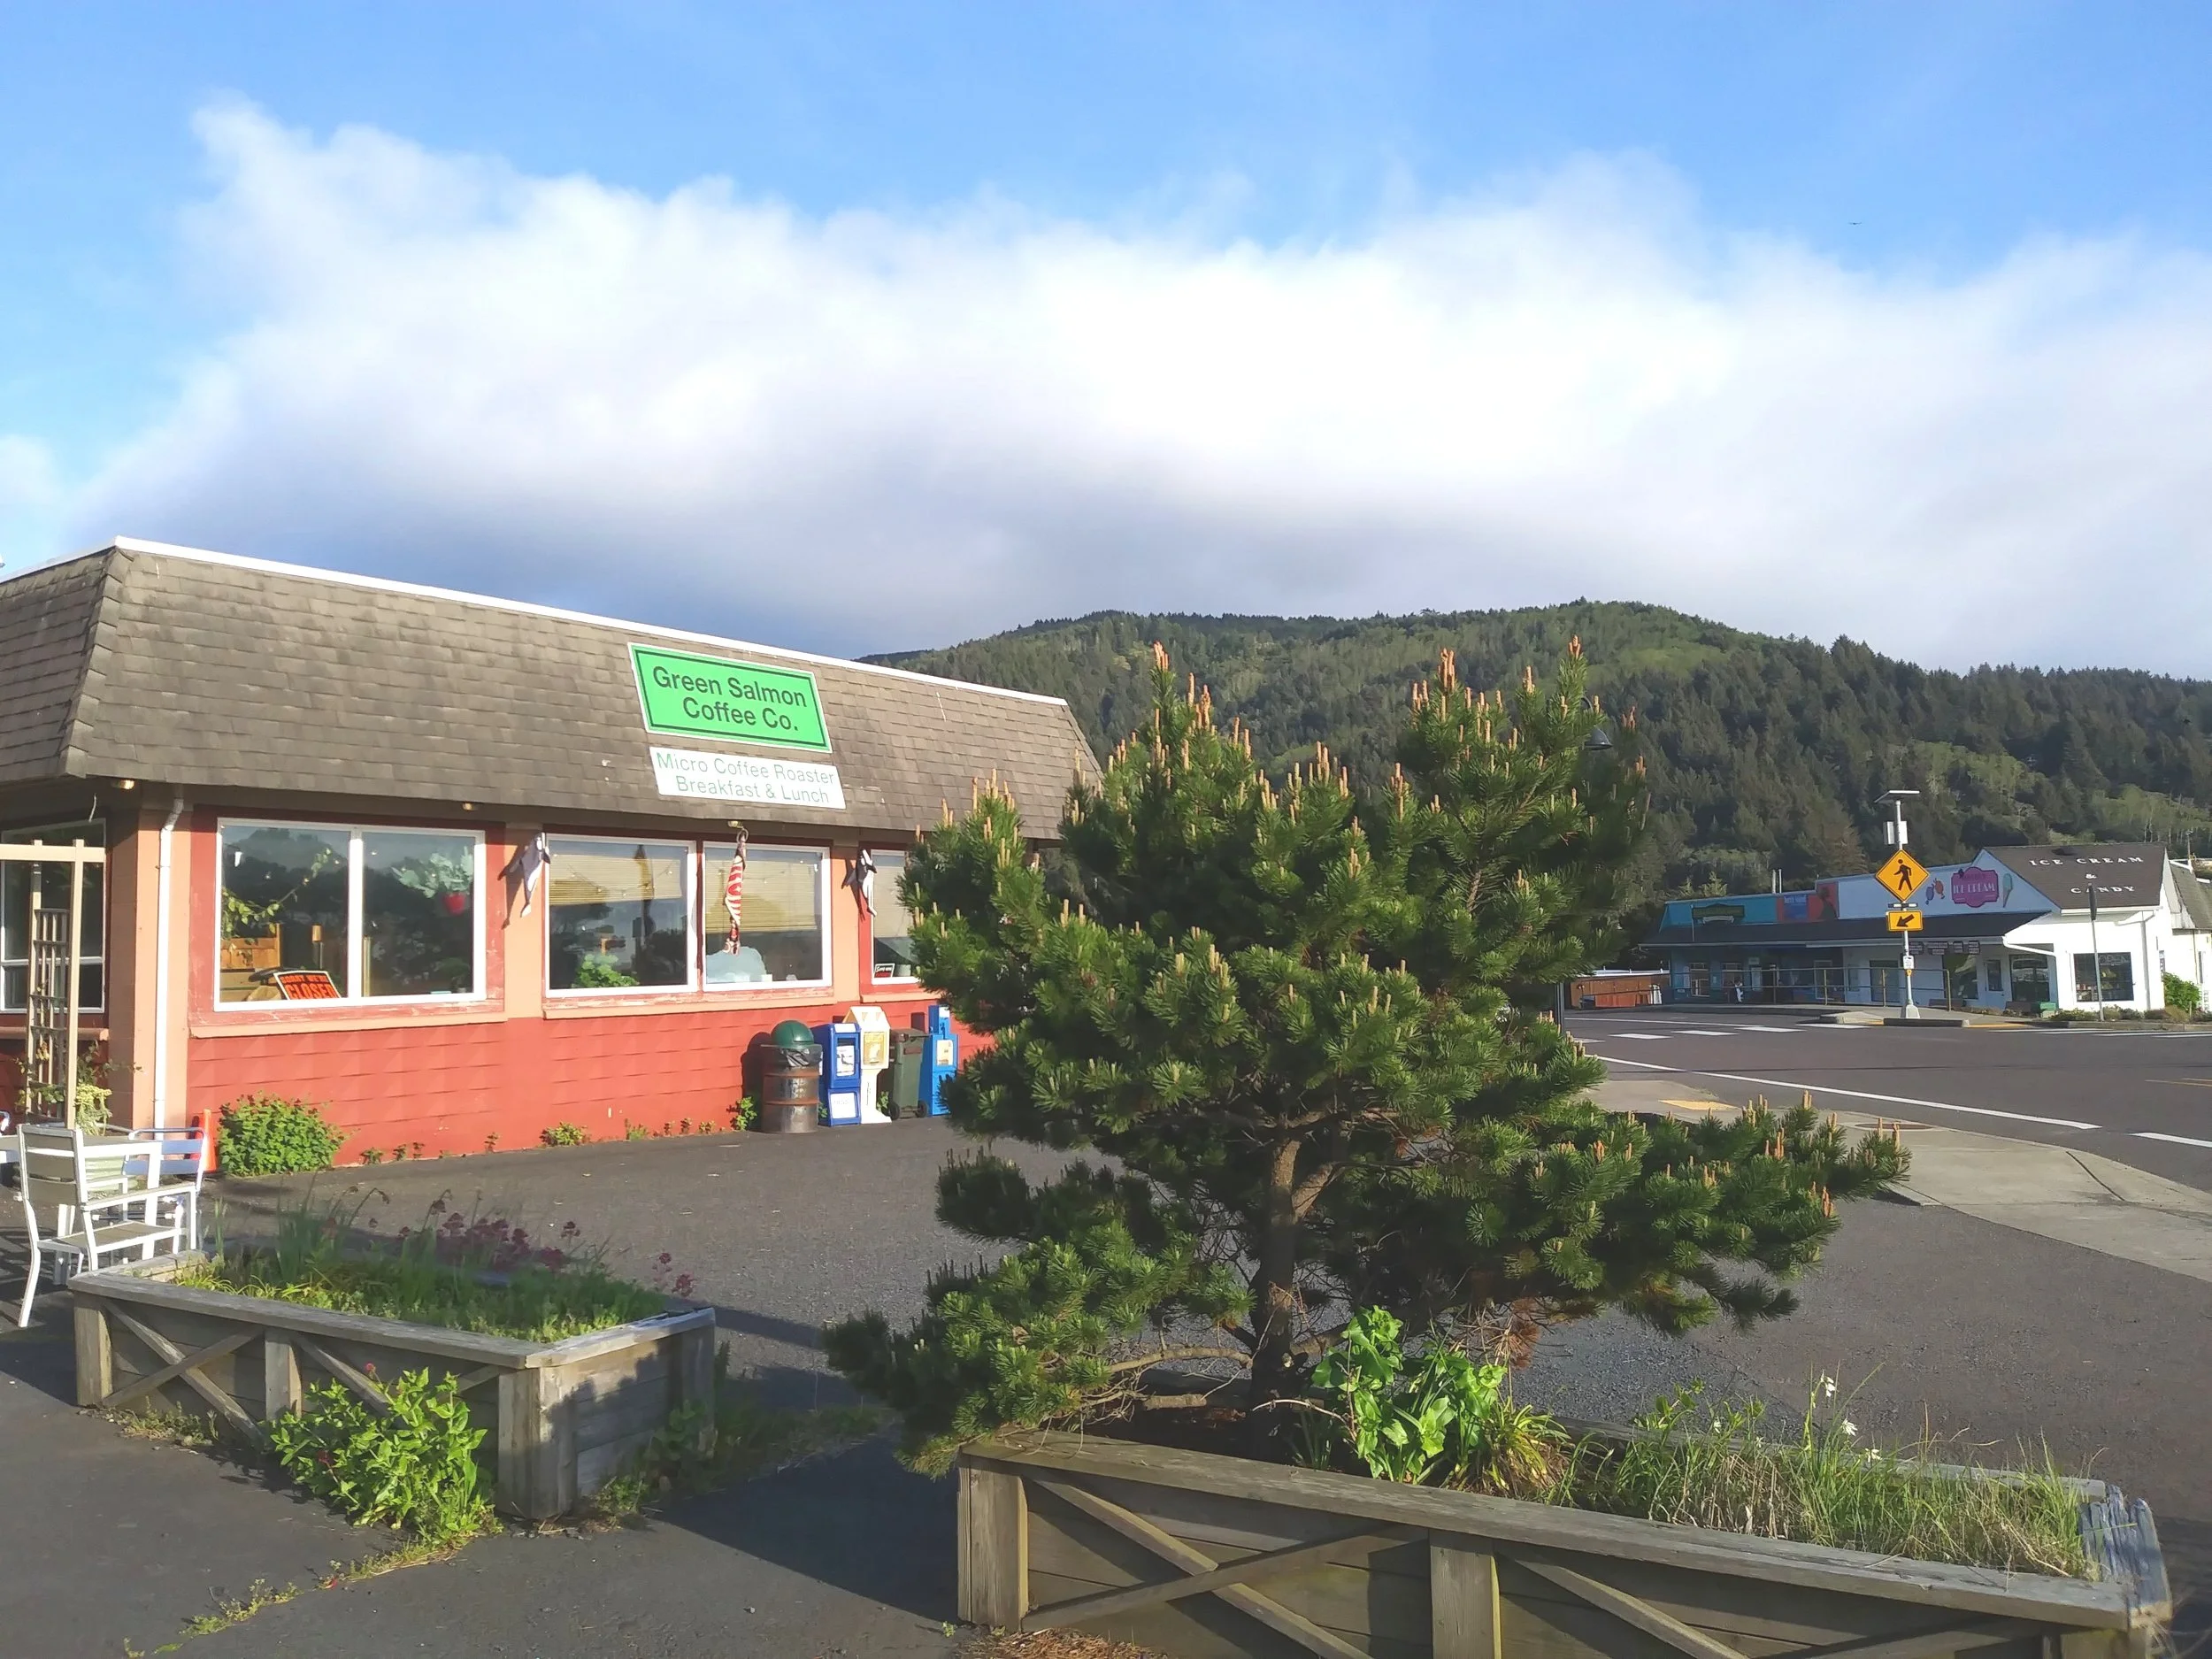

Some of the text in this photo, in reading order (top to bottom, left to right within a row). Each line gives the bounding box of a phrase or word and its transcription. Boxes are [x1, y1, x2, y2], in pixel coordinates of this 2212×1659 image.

[652, 665, 807, 707] Green Salmon
[682, 696, 798, 731] Coffee Co.
[657, 752, 834, 784] Micro Coffee Roaster
[675, 775, 830, 803] Breakfast & Lunch
[285, 983, 340, 1000] CLOSED
